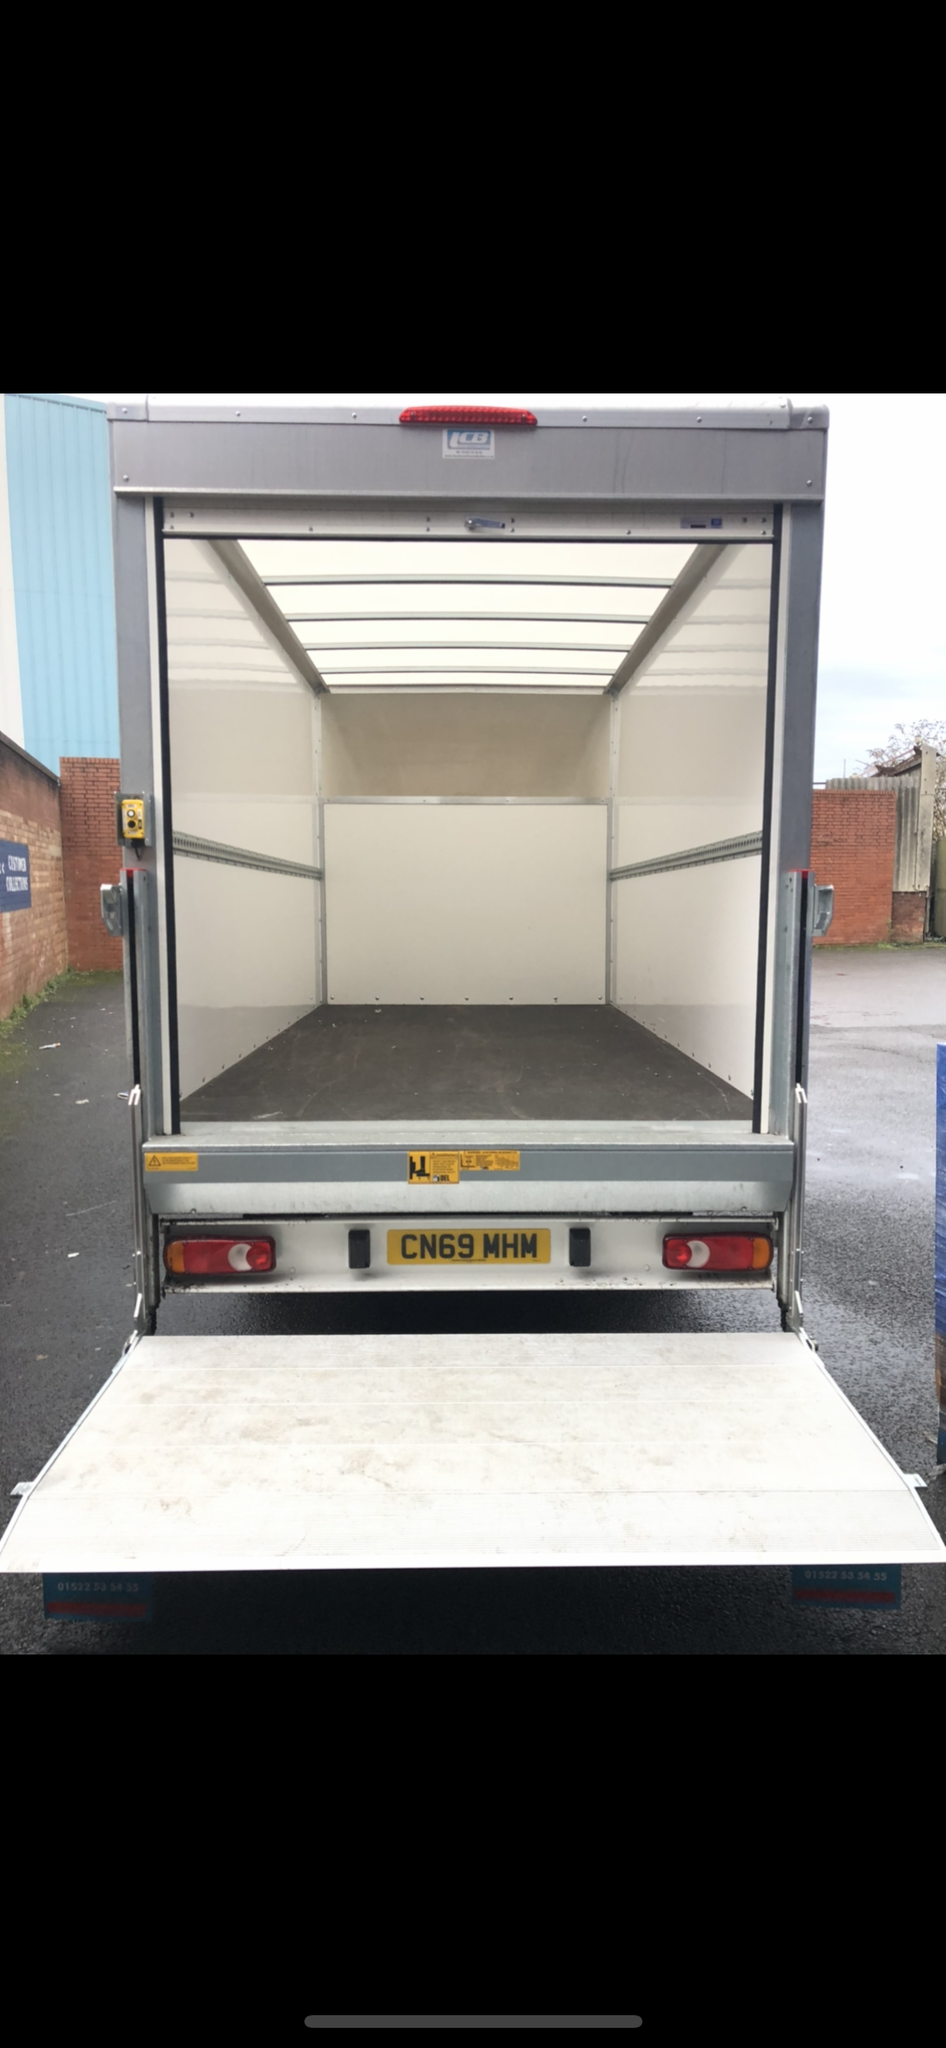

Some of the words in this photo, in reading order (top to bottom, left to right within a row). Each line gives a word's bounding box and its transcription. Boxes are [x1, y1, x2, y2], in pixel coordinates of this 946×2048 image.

[401, 1233, 475, 1259] CN69
[483, 1232, 537, 1258] MHM
[804, 1570, 838, 1580] 01522
[840, 1570, 854, 1580] 53
[857, 1571, 871, 1580] 54
[873, 1572, 888, 1581] 55
[57, 1581, 91, 1592] 01522
[93, 1581, 107, 1592] 53
[109, 1582, 123, 1592] 54
